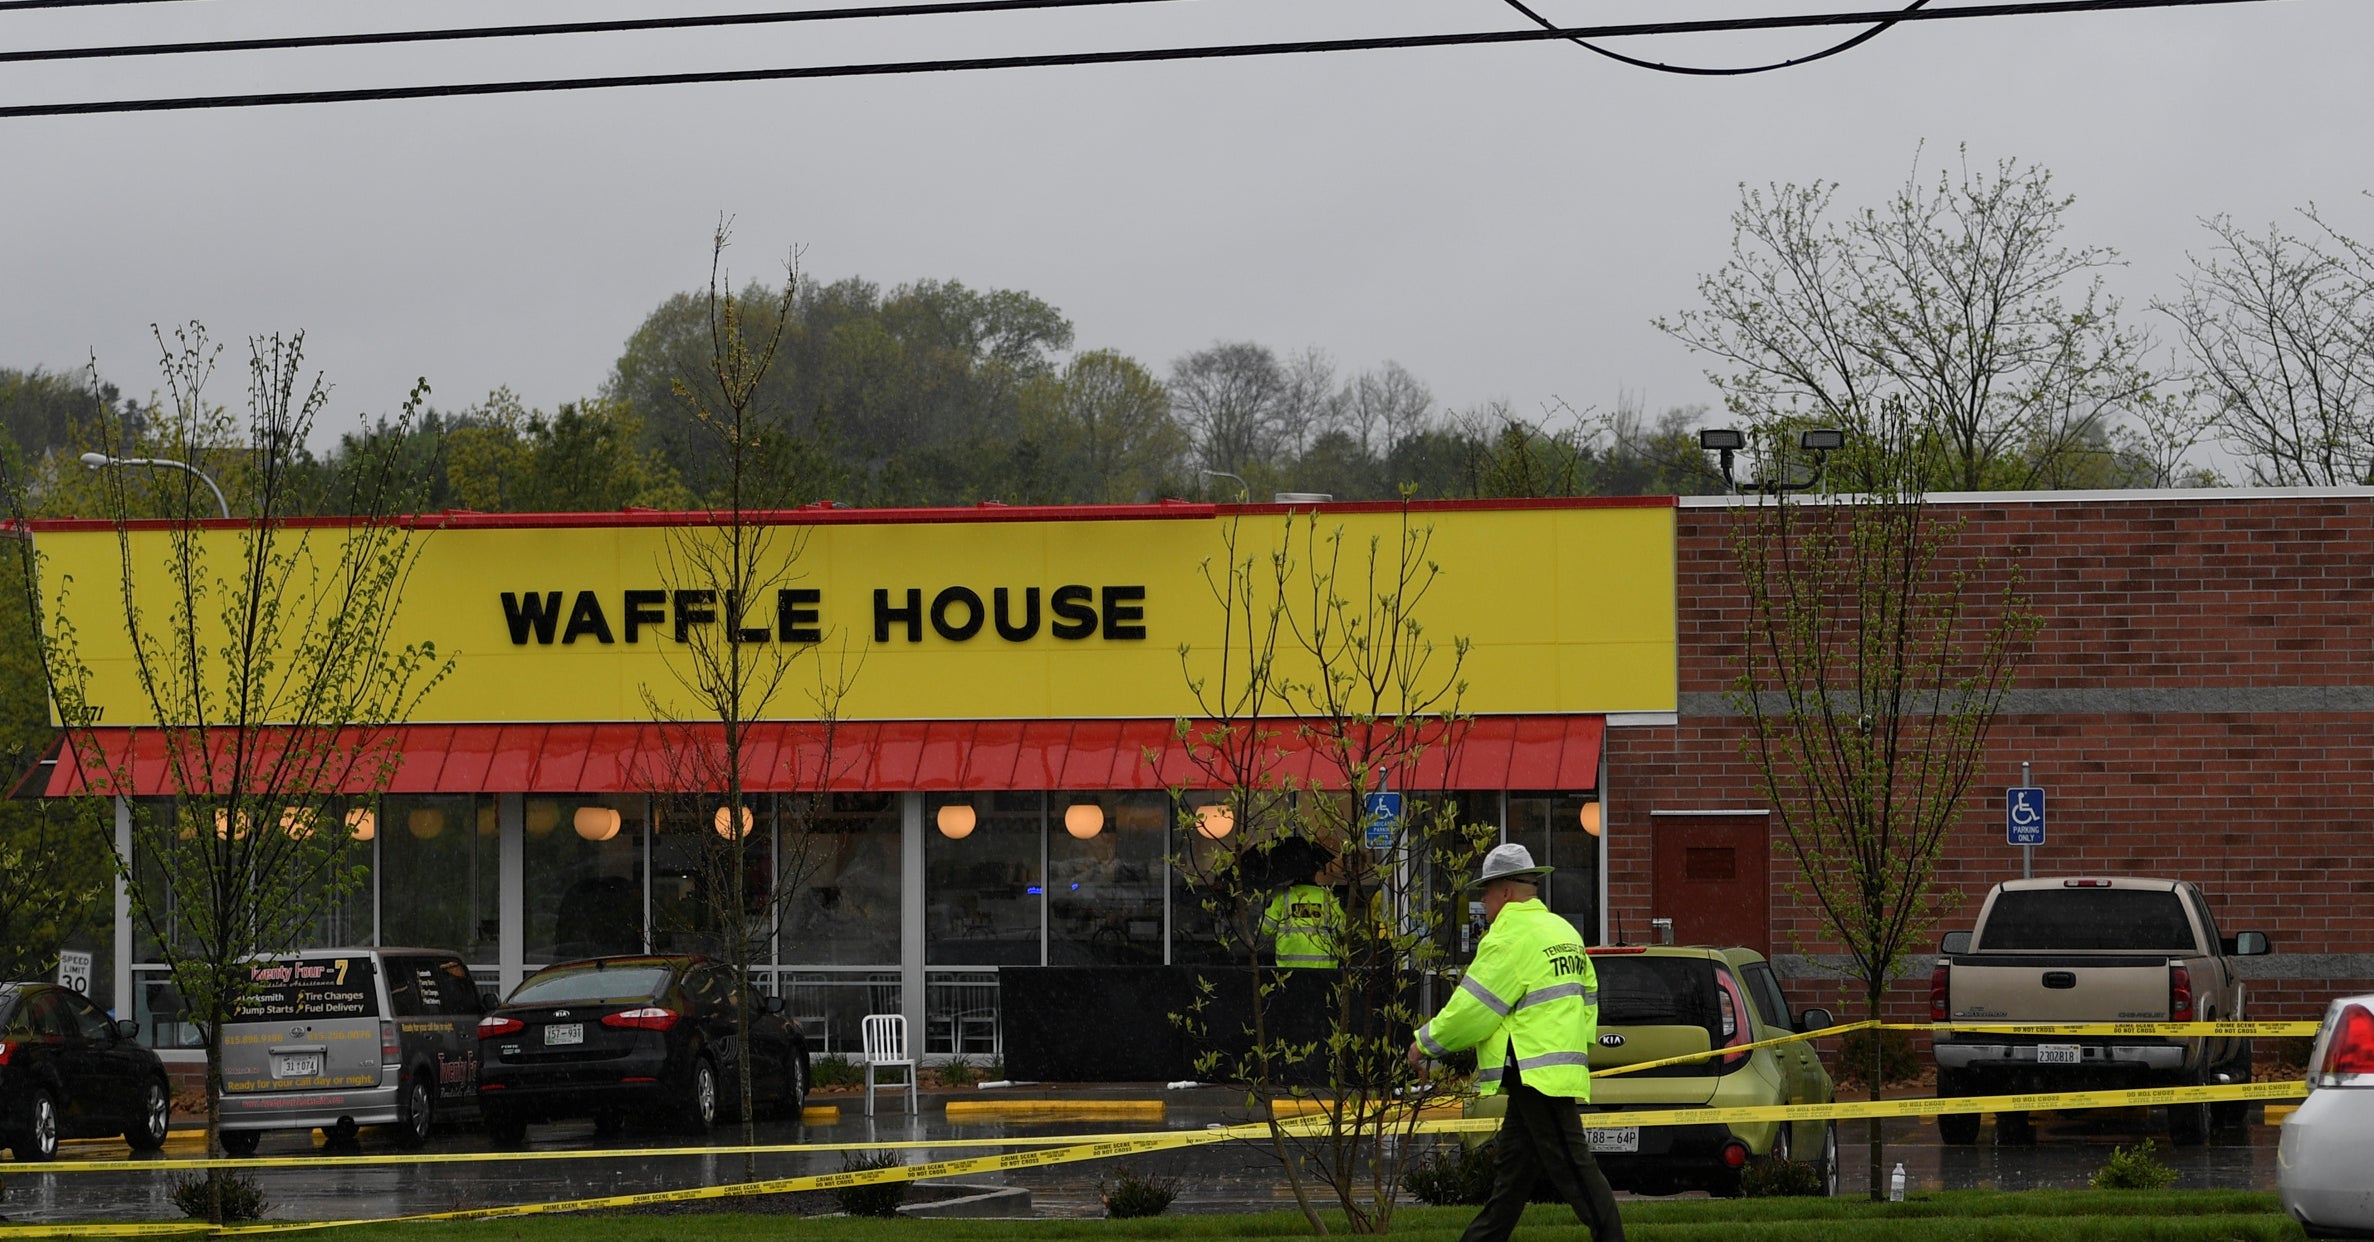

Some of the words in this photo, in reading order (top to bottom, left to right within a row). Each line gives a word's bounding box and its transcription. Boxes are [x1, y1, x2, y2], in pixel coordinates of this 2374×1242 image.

[500, 588, 821, 644] WAFFLE
[873, 584, 1146, 642] HOUSE
[2012, 825, 2040, 834] PARKING
[2018, 834, 2035, 842] ONLY
[62, 955, 89, 966] SPEED
[64, 965, 85, 975] LIMIT
[251, 964, 293, 982] Twenty
[295, 962, 325, 979] Four
[62, 975, 87, 993] 30
[305, 992, 322, 1000] Tire
[324, 991, 364, 1001] Changes
[241, 1006, 265, 1016] Jump
[267, 1005, 294, 1014] Starts
[305, 1004, 324, 1012] Fuel
[326, 1002, 364, 1013] Delivery
[1603, 1036, 1621, 1044] KIA
[2040, 1051, 2074, 1061] 2302818
[228, 1081, 255, 1091] Ready
[257, 1079, 270, 1088] for
[273, 1078, 293, 1089] your
[295, 1076, 311, 1086] call
[314, 1076, 331, 1086] day
[1587, 1131, 1636, 1144] T88-64P
